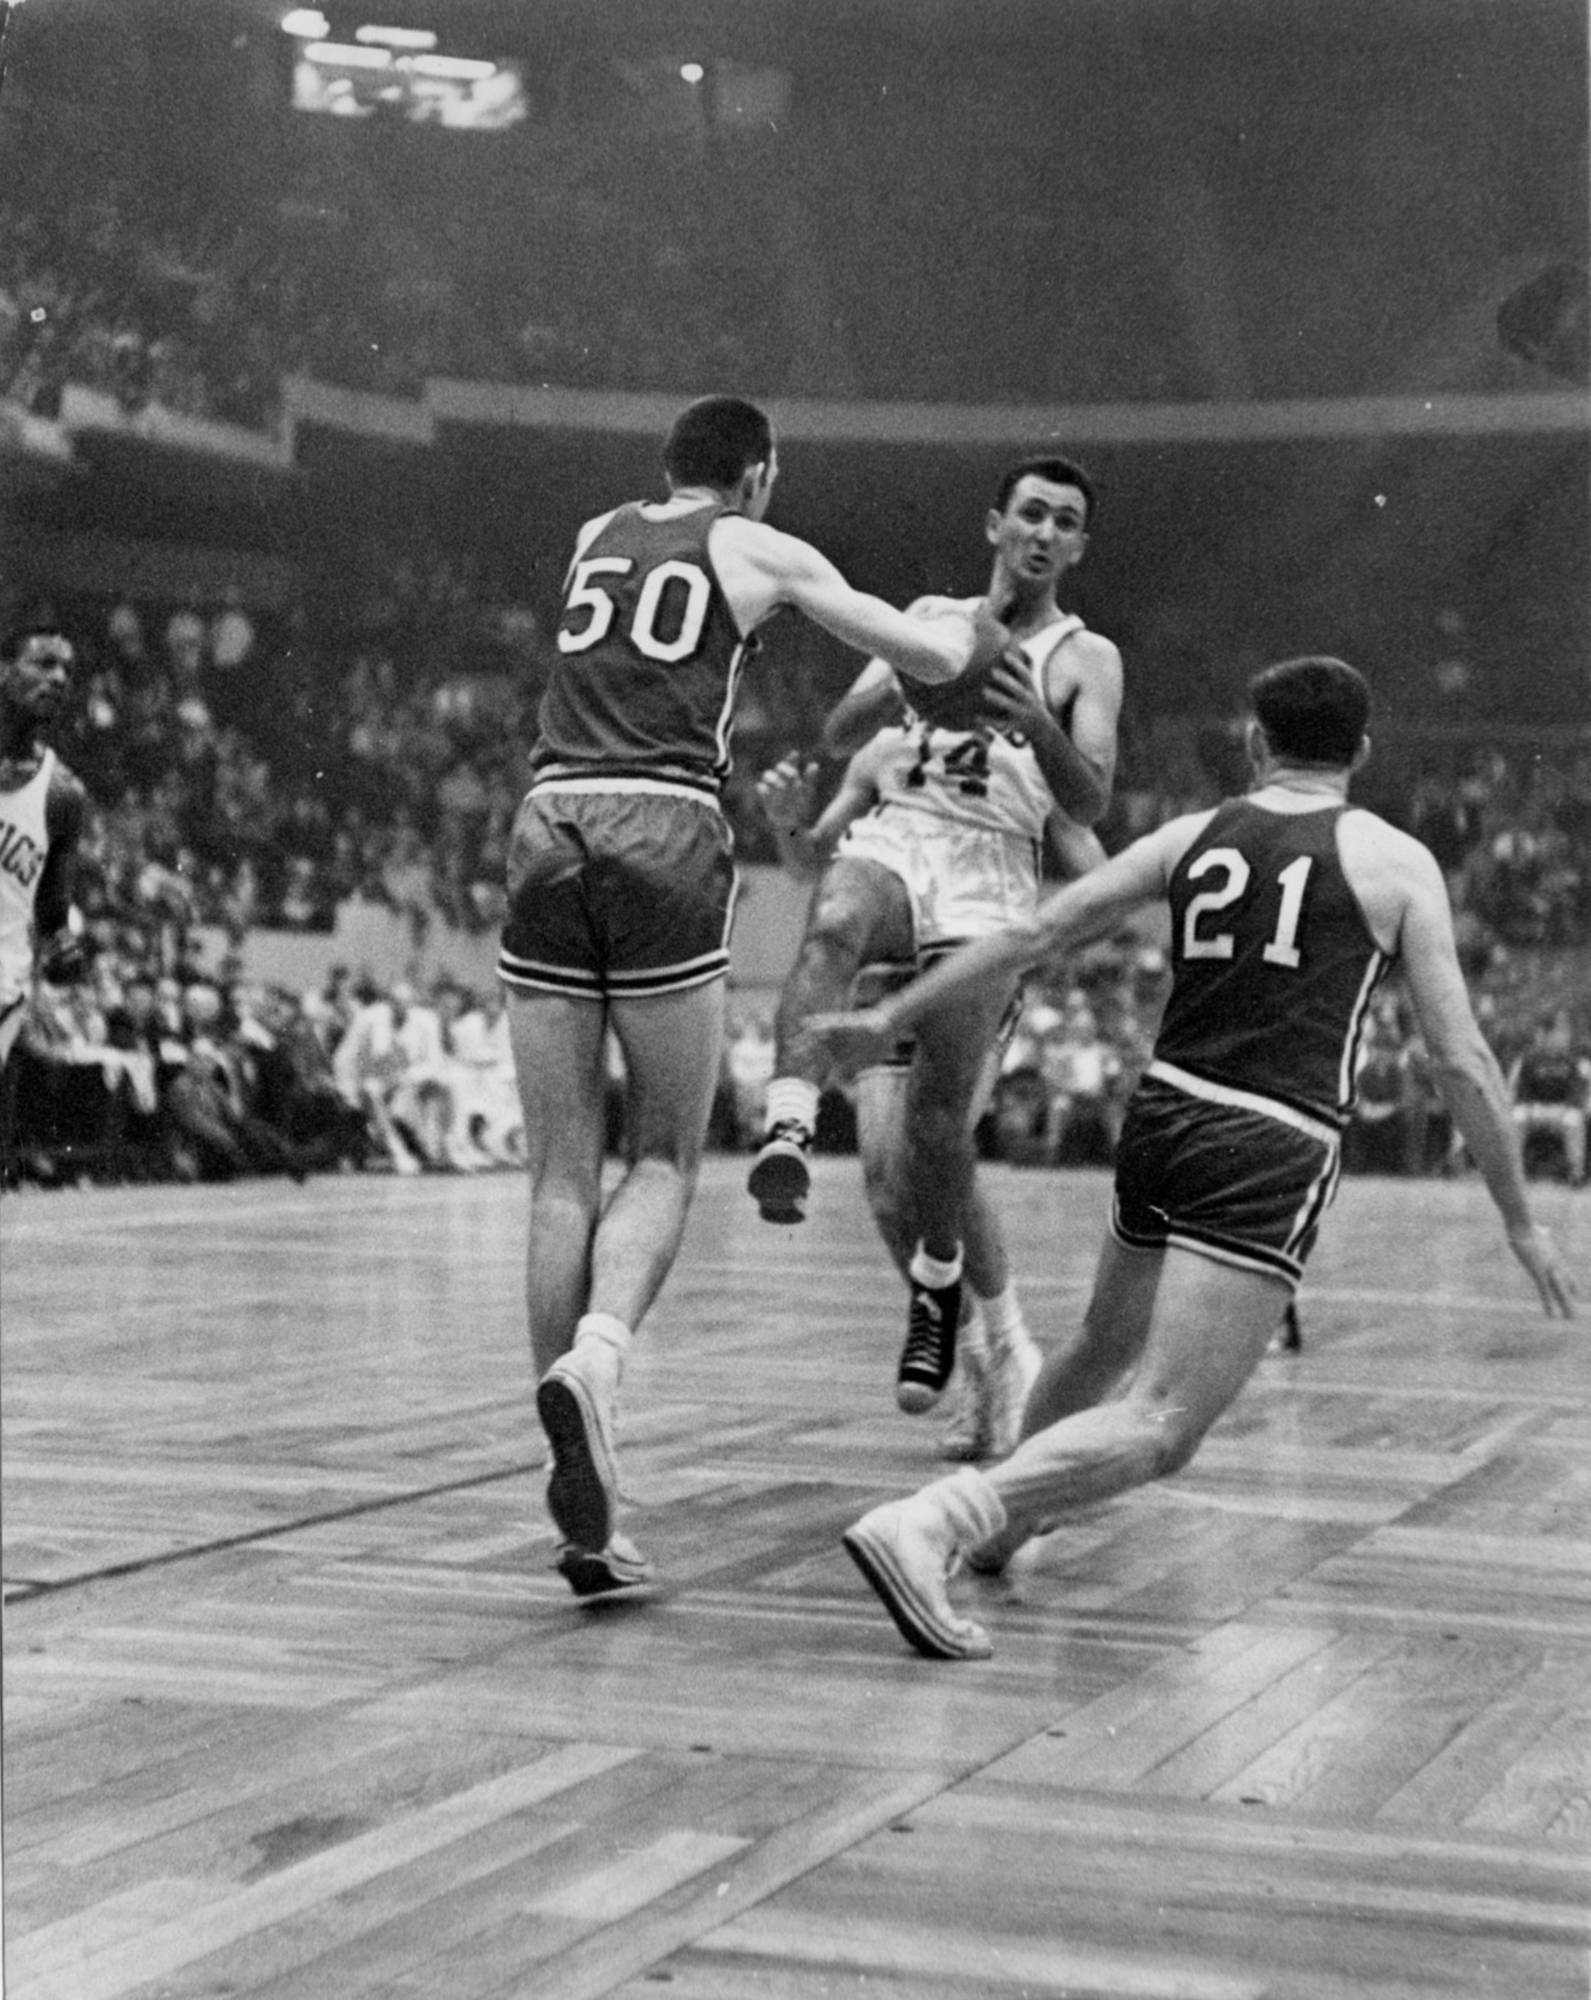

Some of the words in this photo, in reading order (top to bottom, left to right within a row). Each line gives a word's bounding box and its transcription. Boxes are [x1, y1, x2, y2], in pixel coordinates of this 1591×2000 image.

[558, 556, 710, 662] 50
[906, 736, 991, 797] 14
[0, 820, 44, 887] ICS
[1184, 847, 1313, 969] 21
